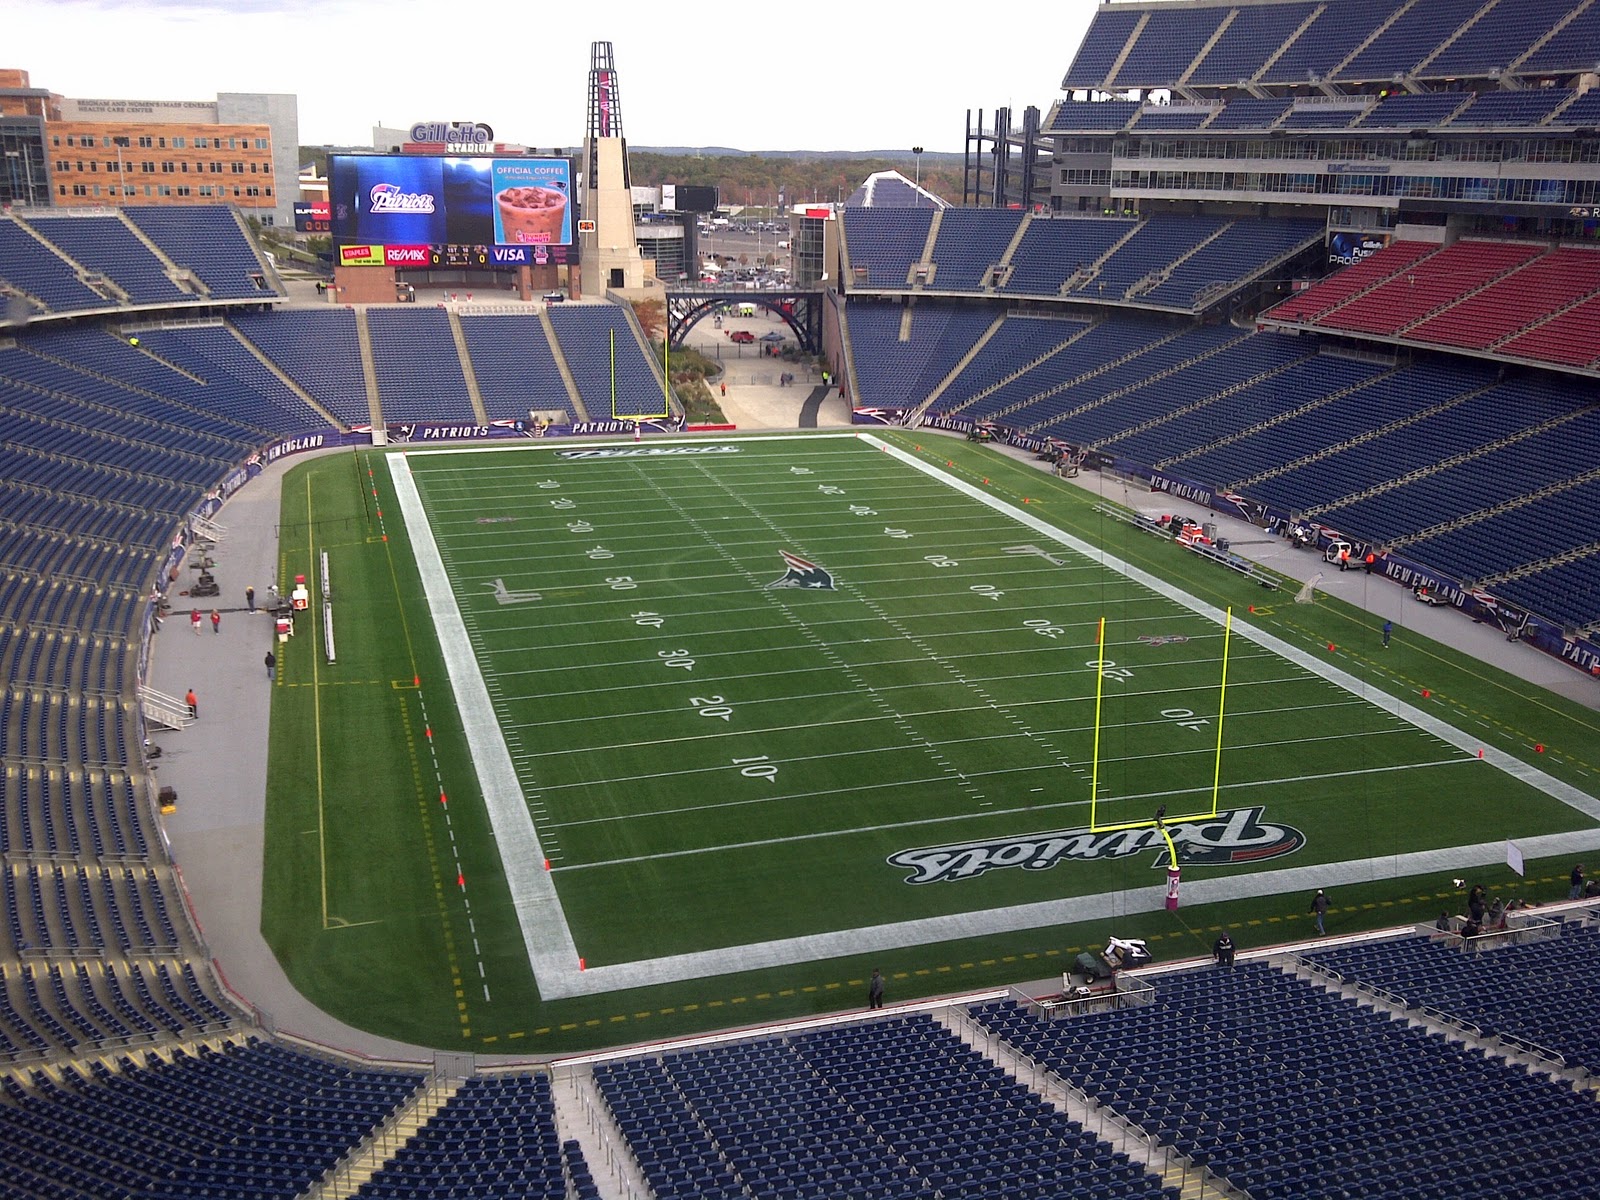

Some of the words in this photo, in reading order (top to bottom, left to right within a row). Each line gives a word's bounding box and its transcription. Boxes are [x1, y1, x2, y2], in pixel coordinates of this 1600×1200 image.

[411, 122, 488, 143] Gillette
[447, 143, 494, 153] STADIUM
[371, 184, 435, 213] Patriots
[343, 248, 371, 258] STAPLES
[387, 249, 426, 261] RE/MAX
[433, 255, 440, 264] 0
[479, 255, 486, 264] 0
[494, 249, 526, 261] VISA
[423, 426, 489, 439] PATRIOTS
[934, 418, 973, 433] ENGLAND
[282, 435, 324, 454] ENGLAND
[1011, 434, 1047, 452] PATRIOT
[1149, 474, 1170, 491] NEW
[1170, 482, 1212, 505] ENGLAND
[924, 555, 959, 568] 50
[1385, 561, 1411, 583] NEW
[605, 576, 638, 590] 50
[688, 695, 733, 718] 20
[731, 755, 778, 778] 10
